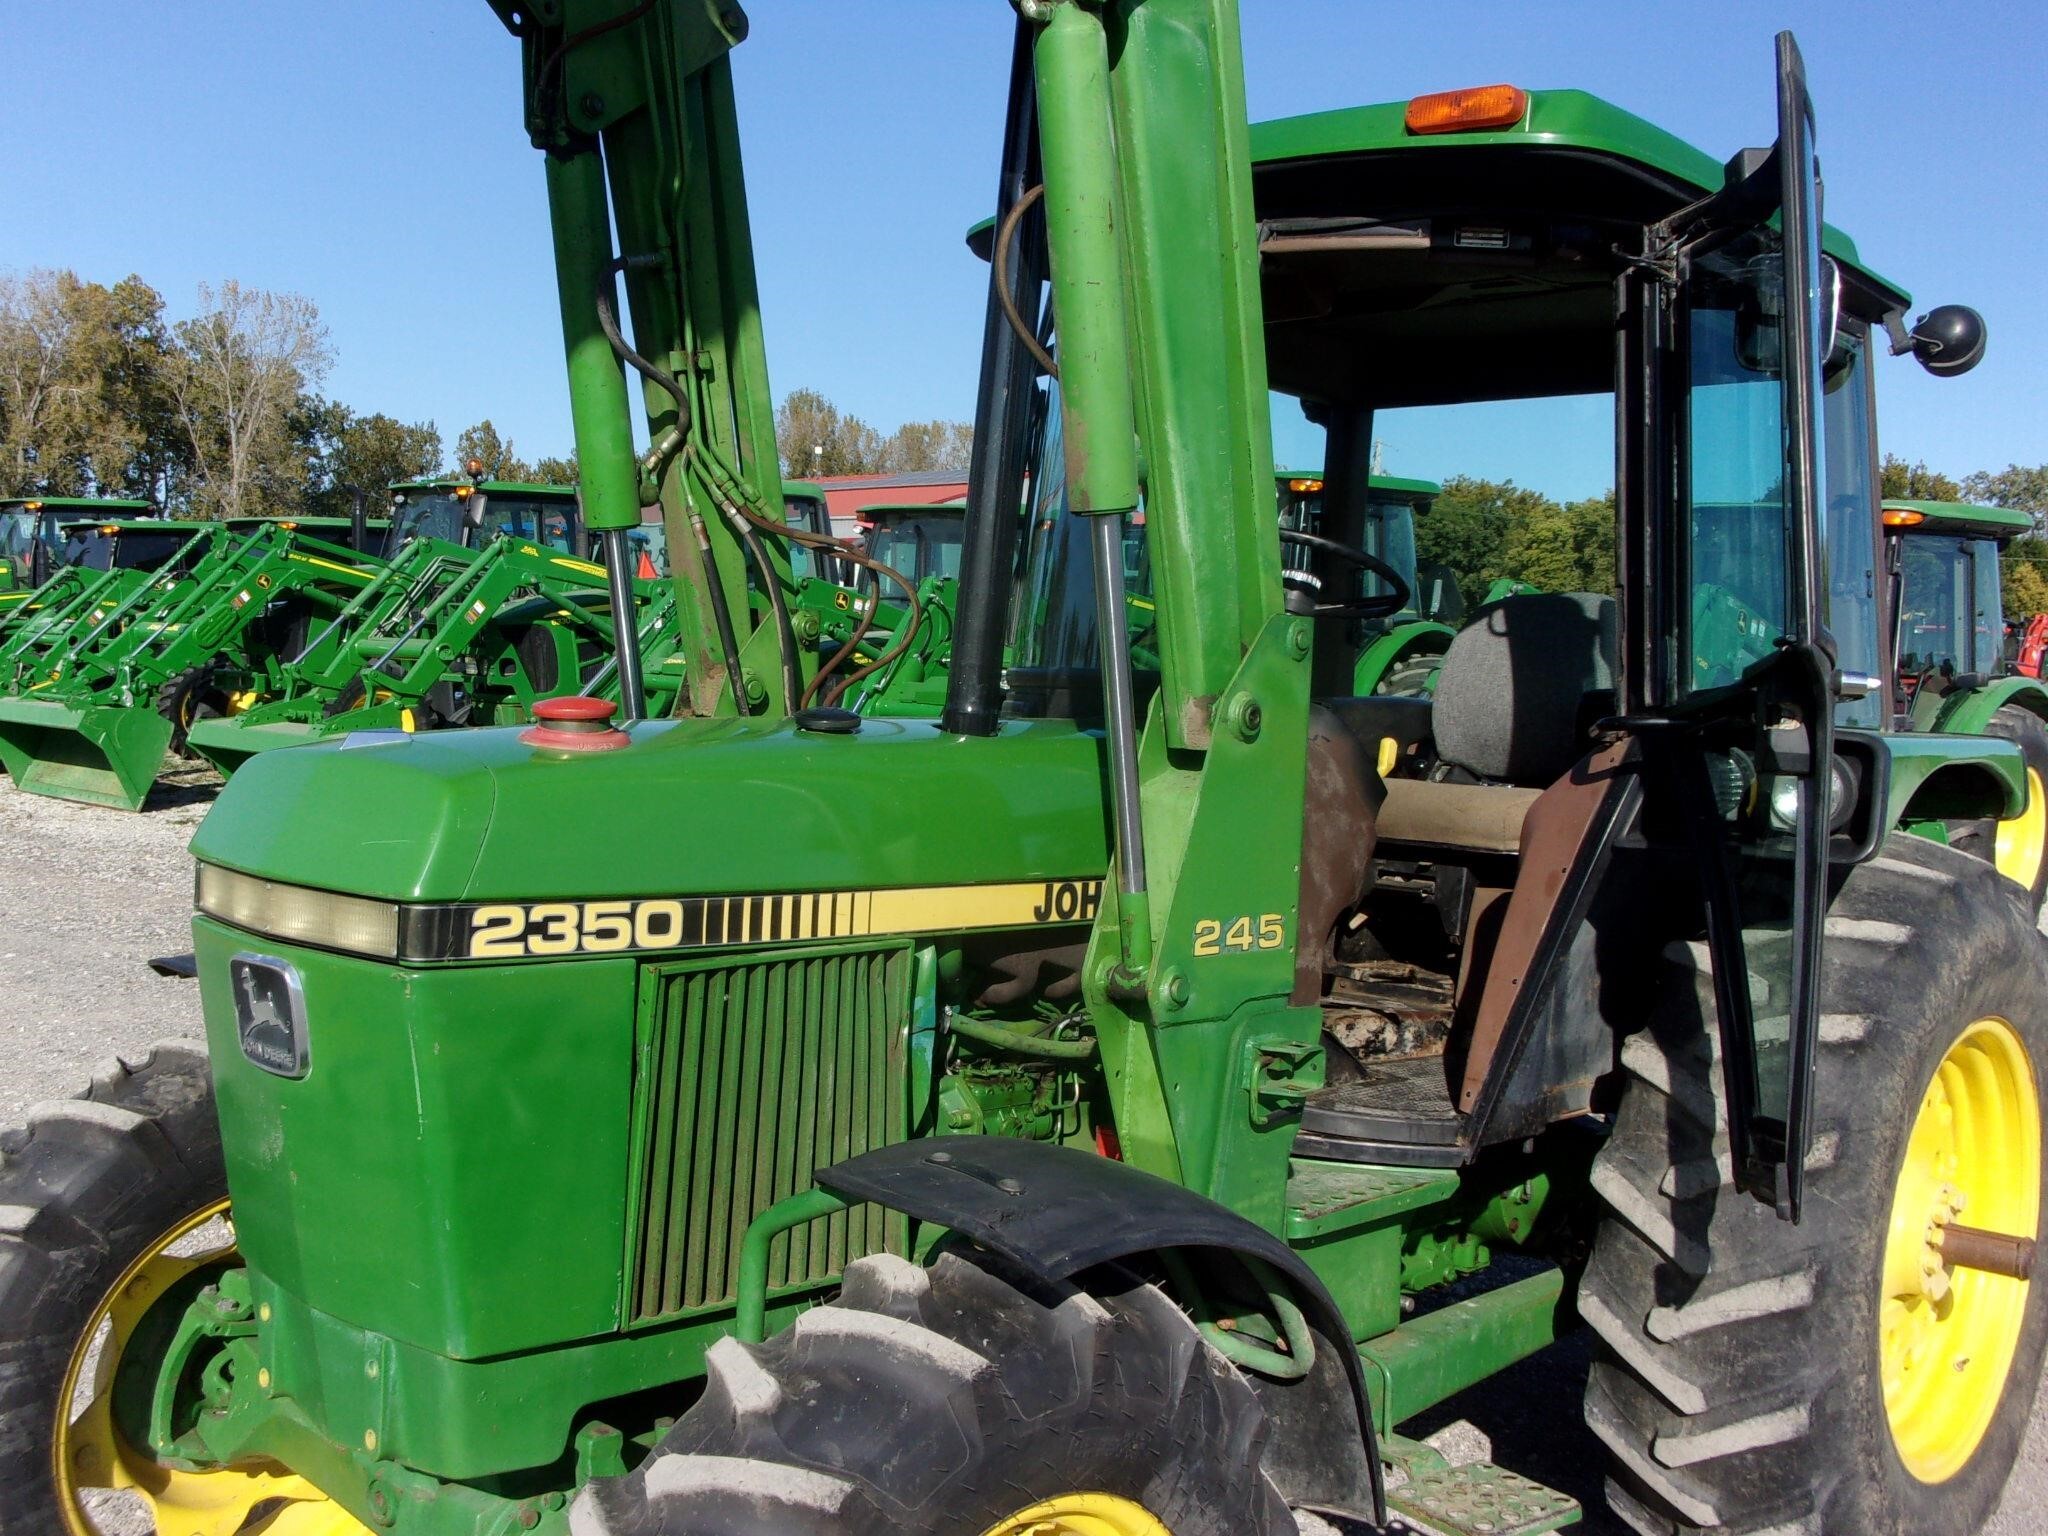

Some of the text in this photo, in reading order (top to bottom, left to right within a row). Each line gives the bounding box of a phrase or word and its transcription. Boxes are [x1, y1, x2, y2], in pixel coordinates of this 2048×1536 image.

[470, 900, 684, 957] 2350
[1193, 913, 1284, 957] 245
[243, 1037, 265, 1058] JOHN
